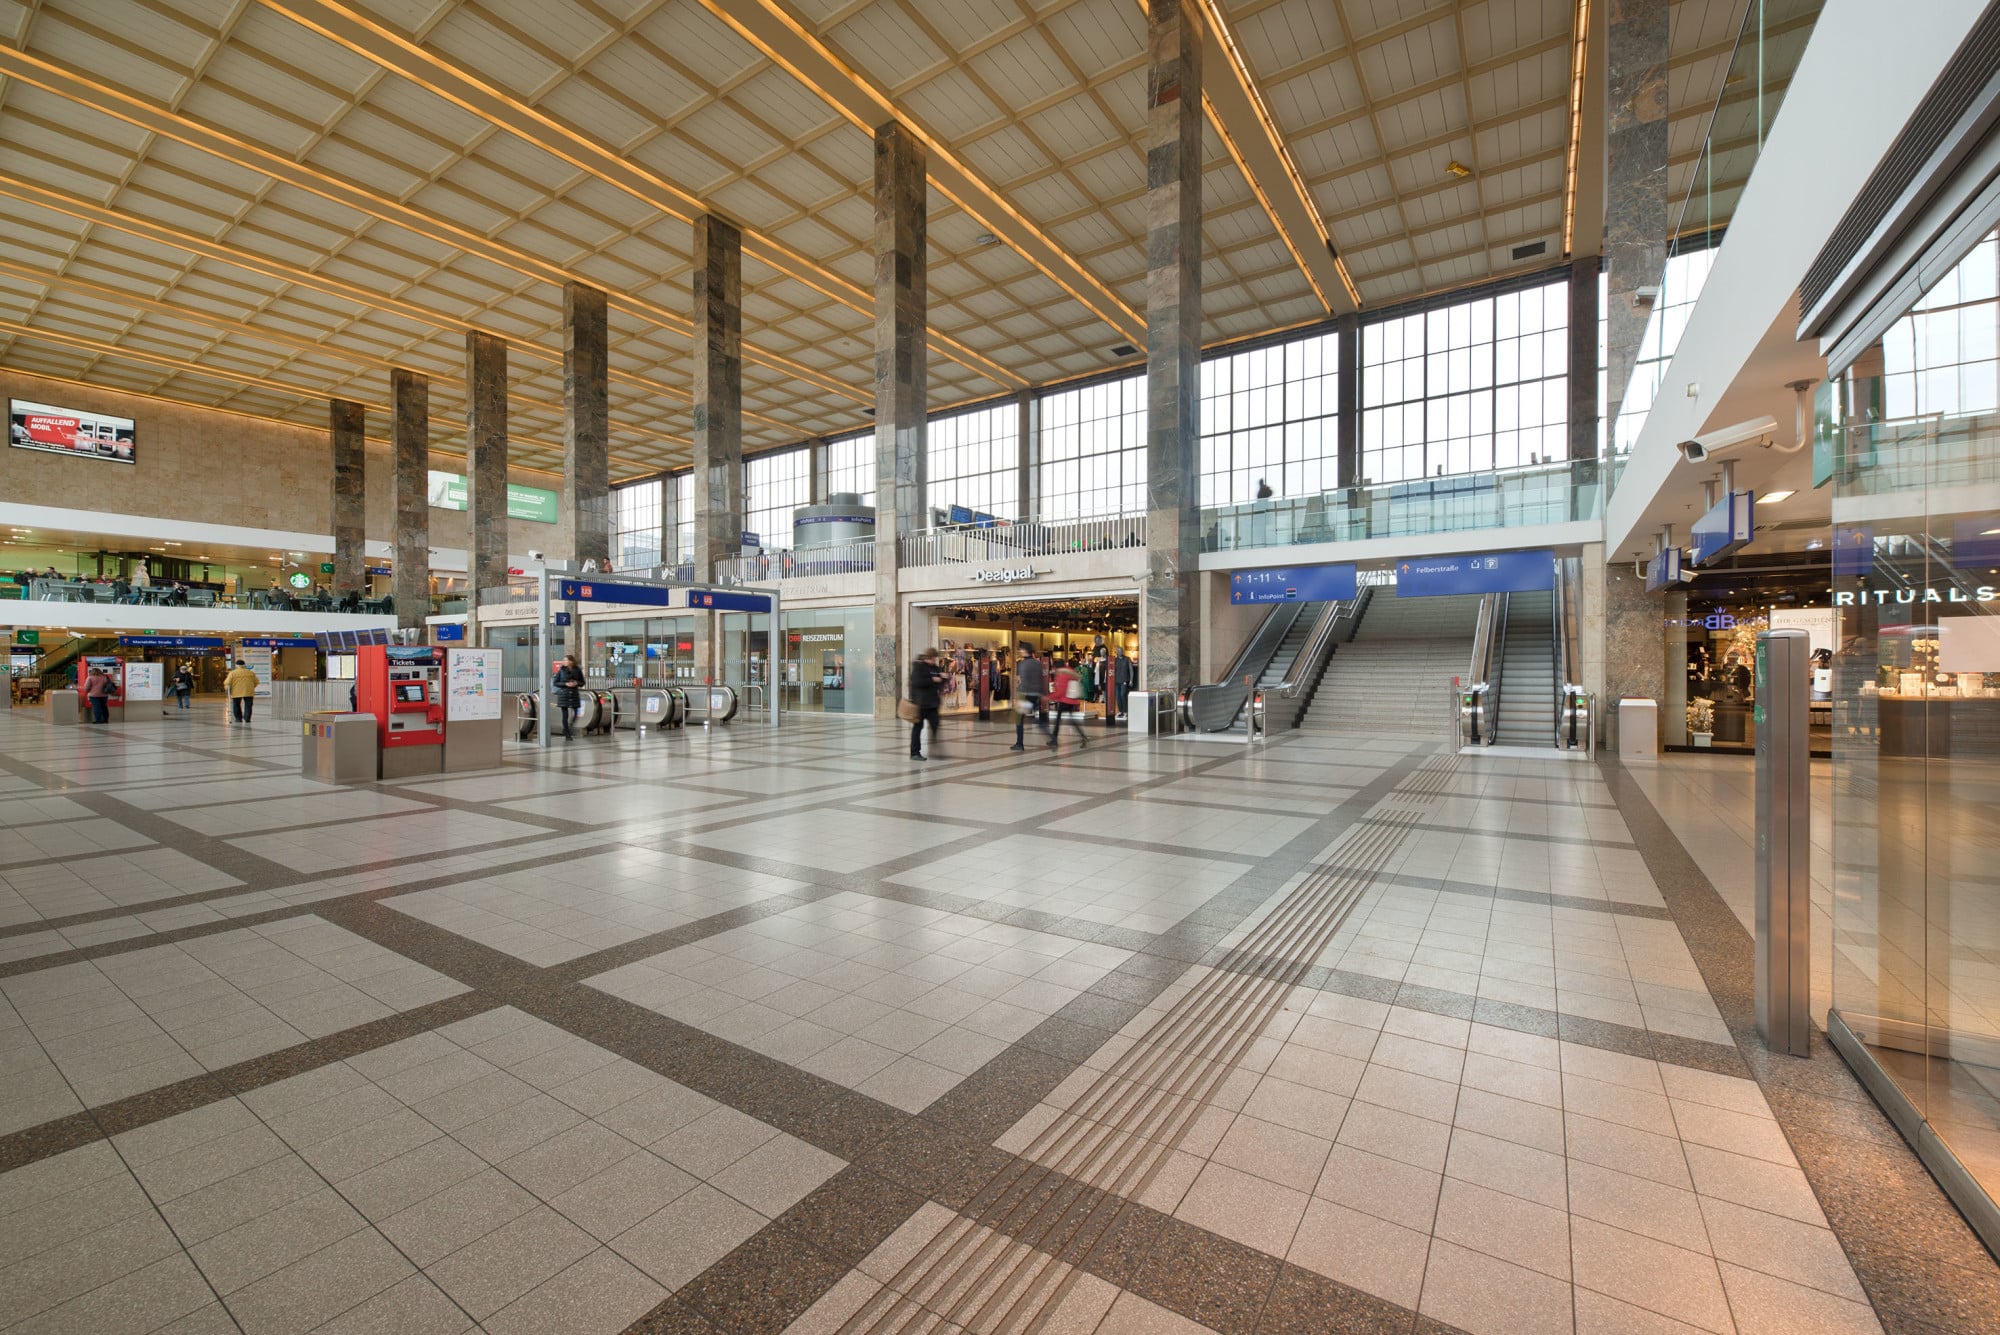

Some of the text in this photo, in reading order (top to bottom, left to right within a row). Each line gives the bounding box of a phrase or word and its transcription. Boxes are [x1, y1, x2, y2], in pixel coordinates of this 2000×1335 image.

[31, 417, 75, 427] AUFFALLEND
[30, 423, 52, 432] MOBIL
[1416, 564, 1460, 574] Felberstraße
[1247, 573, 1270, 584] 1-11
[1836, 585, 1996, 606] RITUALS
[802, 633, 844, 642] REISEZENTRUM
